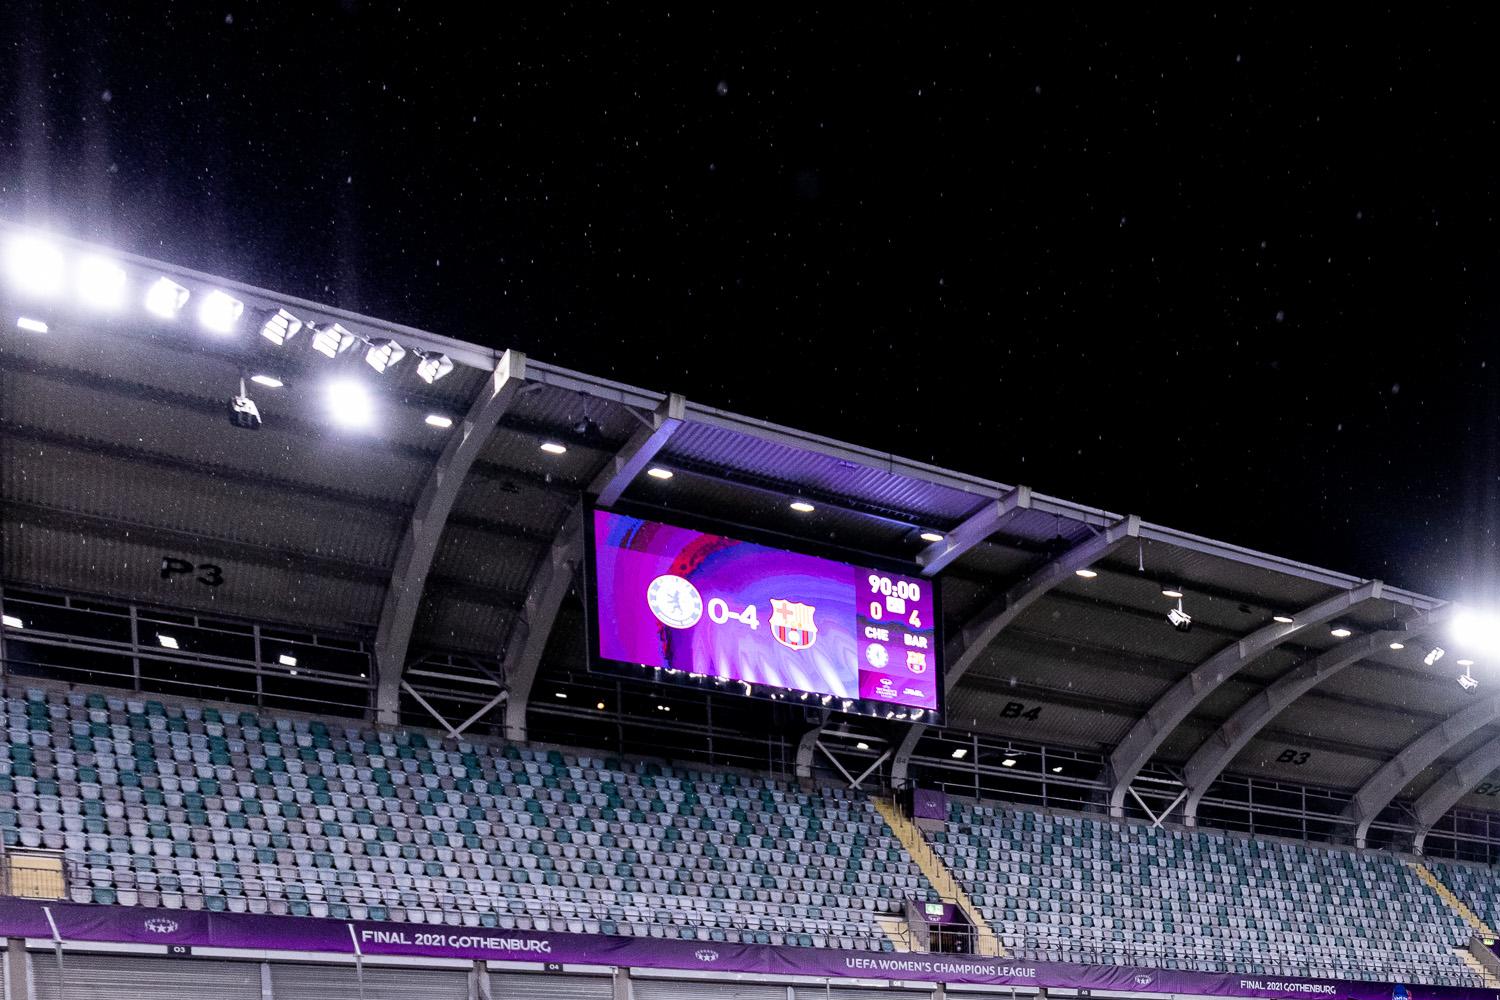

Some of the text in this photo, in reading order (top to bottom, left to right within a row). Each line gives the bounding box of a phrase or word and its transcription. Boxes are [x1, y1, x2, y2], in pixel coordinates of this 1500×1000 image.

[161, 557, 224, 587] P3
[868, 574, 920, 602] 90:00
[708, 598, 759, 630] 0-4
[870, 601, 882, 620] 0
[908, 610, 921, 628] 4
[865, 626, 928, 648] CHE BAR
[1000, 702, 1042, 721] B4
[1275, 749, 1311, 765] B3
[362, 929, 551, 953] FINAL 2021 GOTHENBURG
[846, 957, 1036, 977] UEFA WOMEN'S CHAMPIONS LEAGUE
[1240, 980, 1336, 995] FINAL 2021 GOTHENBURG
